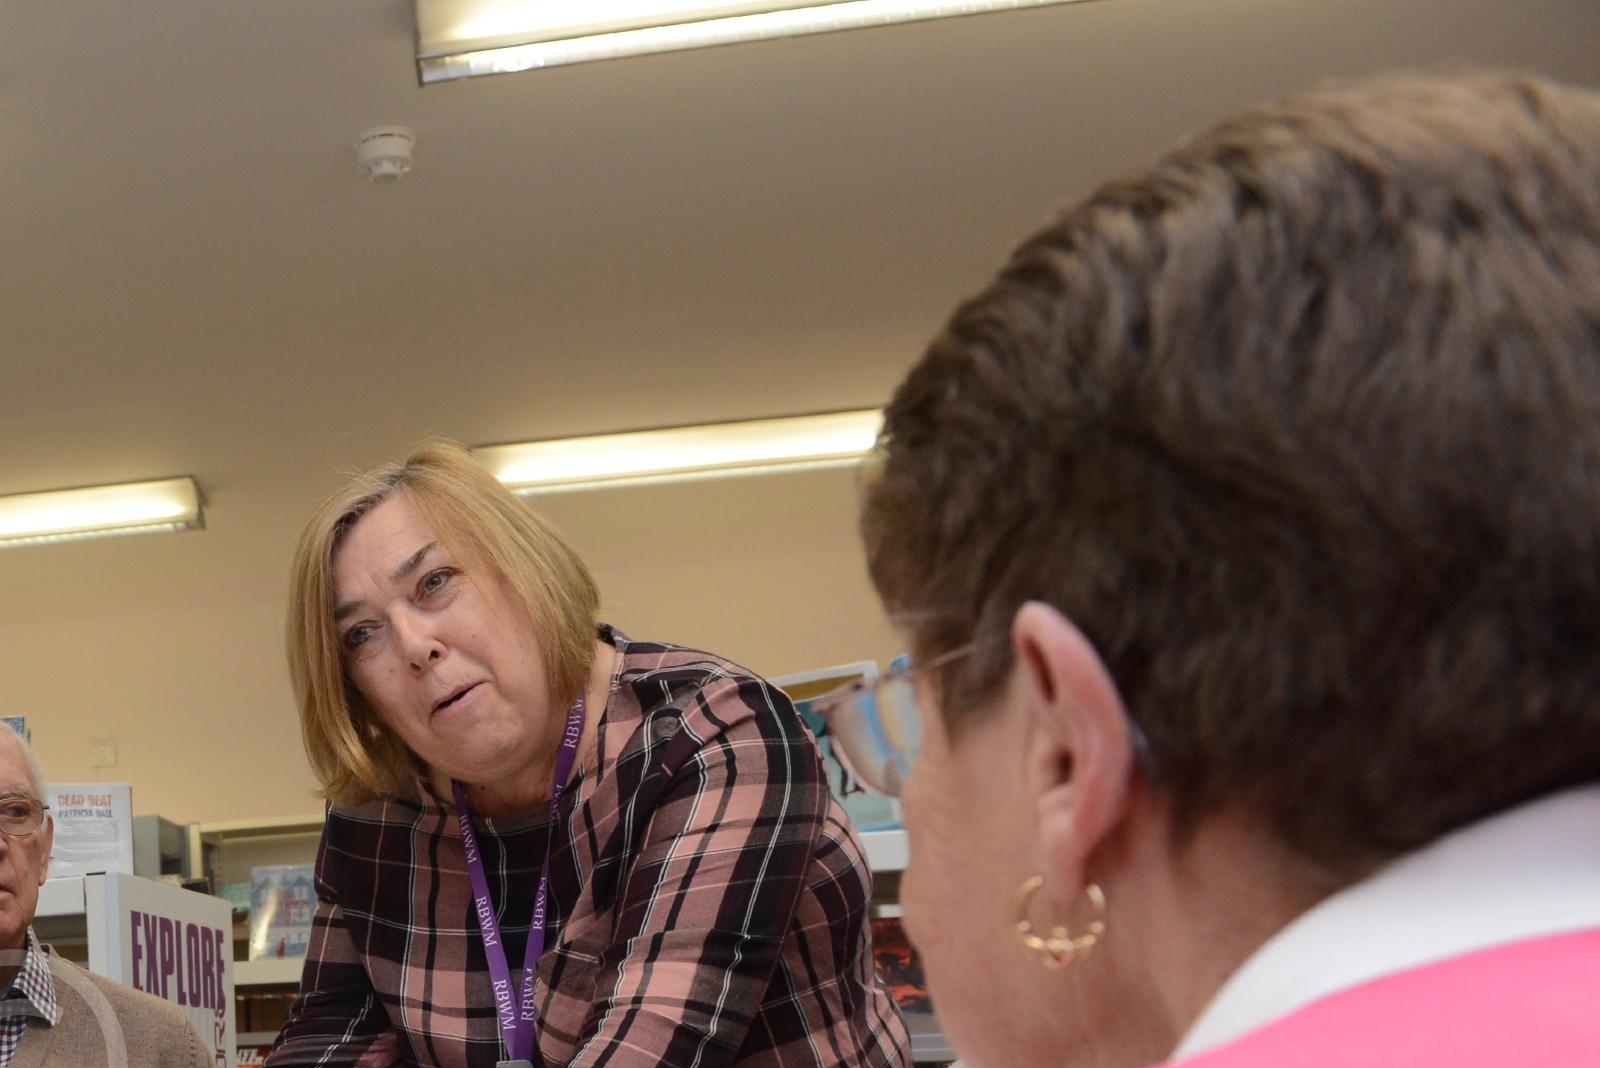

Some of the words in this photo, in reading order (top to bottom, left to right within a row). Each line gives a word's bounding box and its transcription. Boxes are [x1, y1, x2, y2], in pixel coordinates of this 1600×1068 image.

[58, 794, 84, 806] DEAD
[459, 814, 477, 864] RBWM
[476, 896, 498, 947] RBWM
[533, 876, 548, 930] RBWM
[131, 910, 226, 1013] EXPLORE
[494, 979, 516, 1030] RBWM
